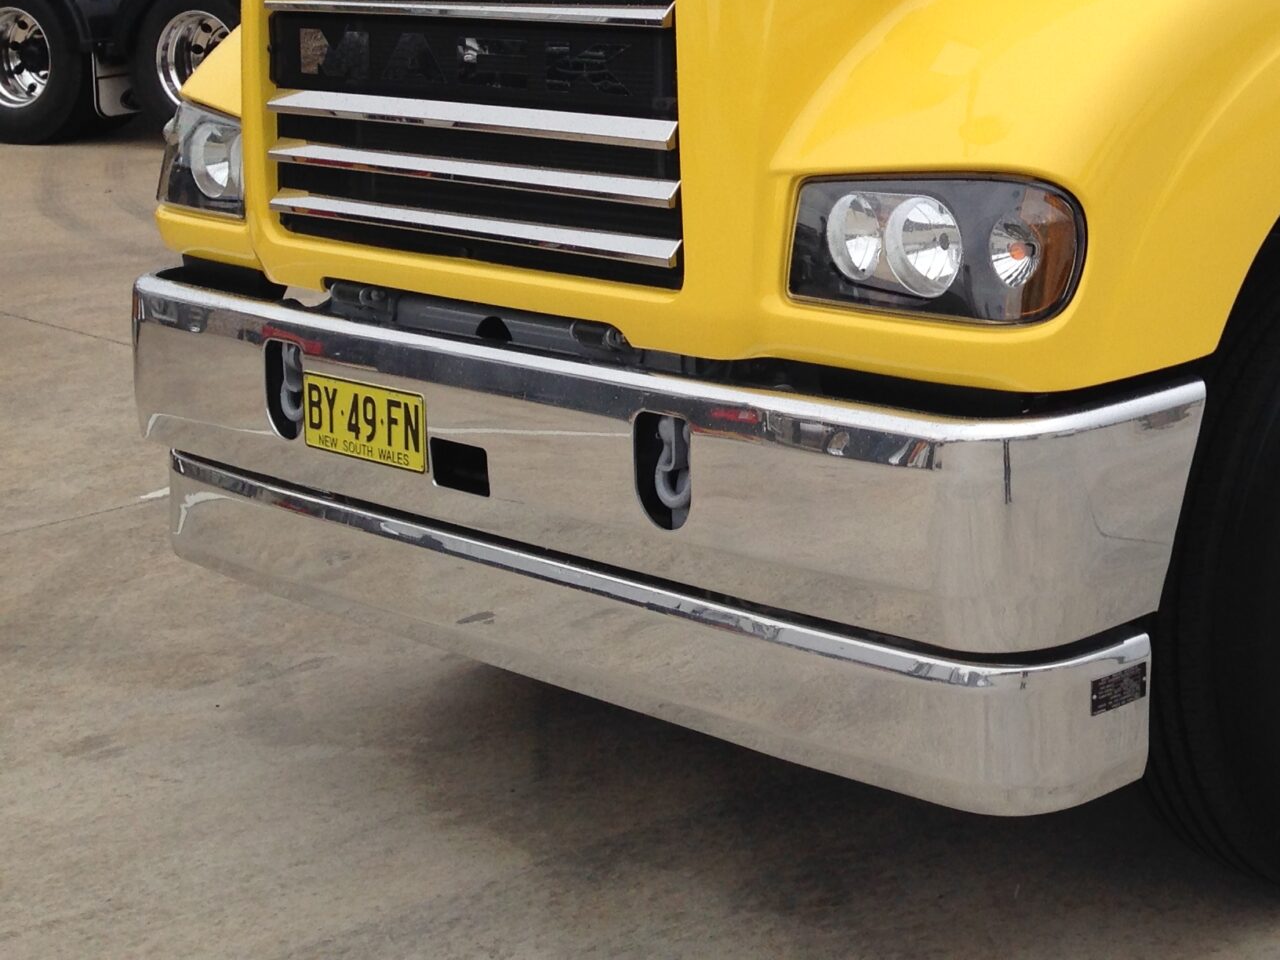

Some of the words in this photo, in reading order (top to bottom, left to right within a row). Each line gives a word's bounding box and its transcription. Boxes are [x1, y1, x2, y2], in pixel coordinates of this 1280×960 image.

[318, 434, 338, 449] NEW
[343, 440, 373, 457] SOUTH
[378, 447, 410, 466] WALES
